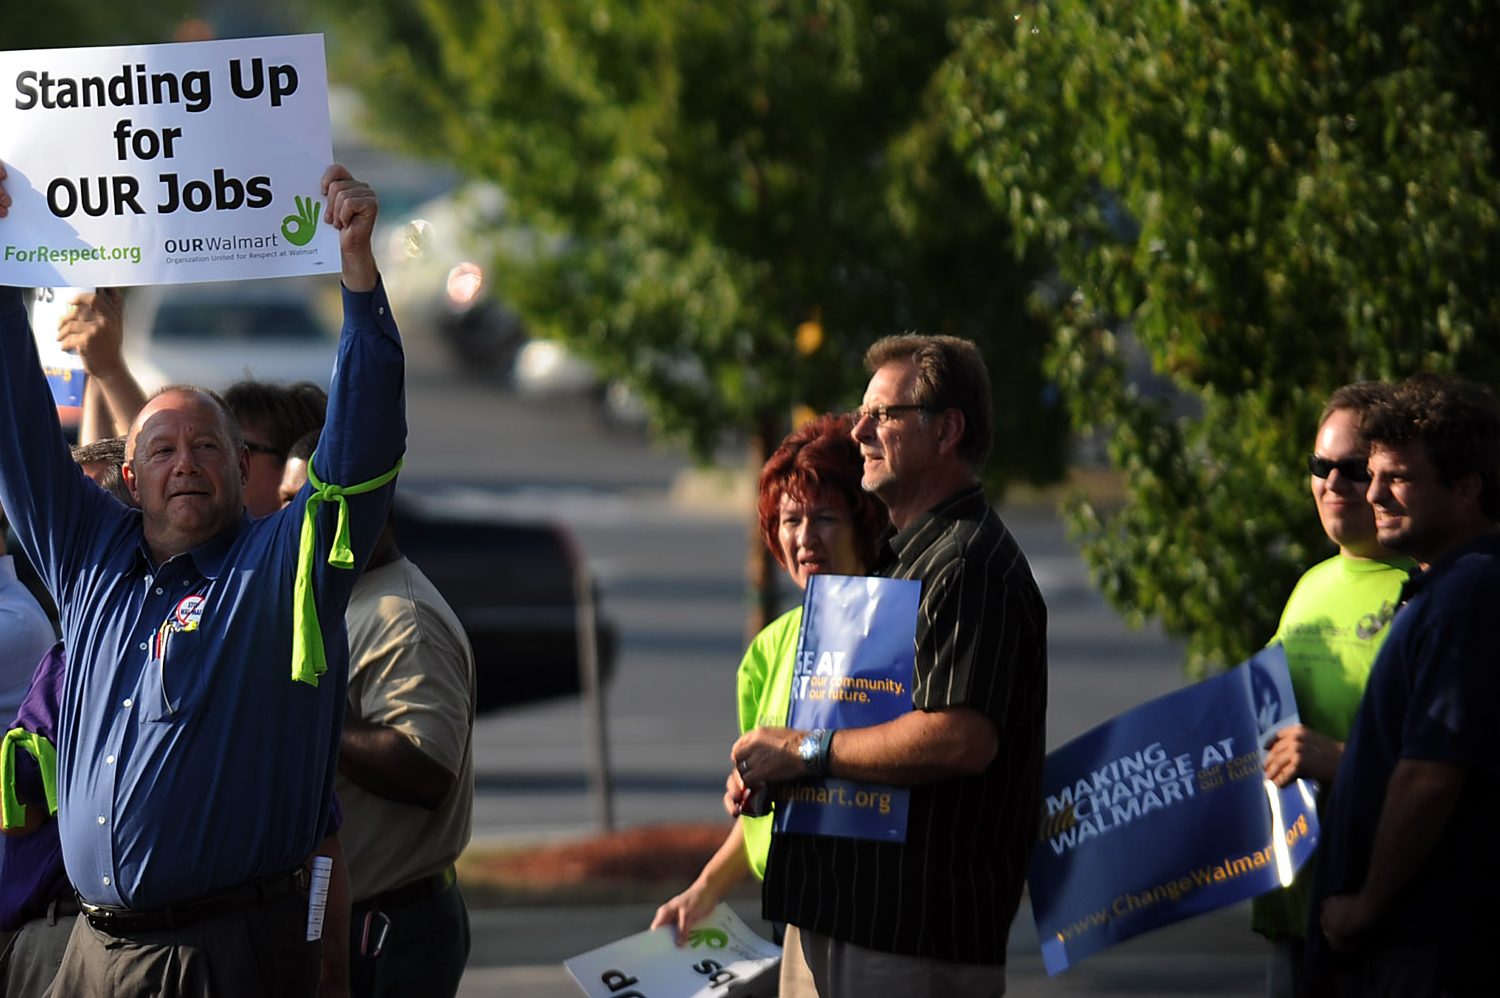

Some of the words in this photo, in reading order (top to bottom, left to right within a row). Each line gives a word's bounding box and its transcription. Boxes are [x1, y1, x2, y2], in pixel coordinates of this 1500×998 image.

[14, 63, 212, 113] Standing
[229, 57, 299, 107] Up
[113, 118, 182, 161] for
[46, 174, 147, 219] OUR
[157, 168, 273, 214] Jobs
[3, 244, 142, 266] ForRespect.org
[165, 255, 210, 265] Organization
[211, 253, 235, 262] United
[236, 252, 247, 261] for
[248, 251, 278, 261] Respect
[288, 248, 319, 257] Walmart
[816, 650, 846, 676] AT
[809, 688, 826, 701] our
[827, 686, 871, 704] future.
[810, 675, 828, 688] our
[830, 675, 906, 695] community.
[1045, 742, 1167, 815] MAKING
[1073, 753, 1195, 822] CHANGE
[1201, 737, 1235, 769] AT
[1200, 775, 1225, 791] our
[1050, 772, 1196, 856] WALMART
[1197, 763, 1221, 780] our
